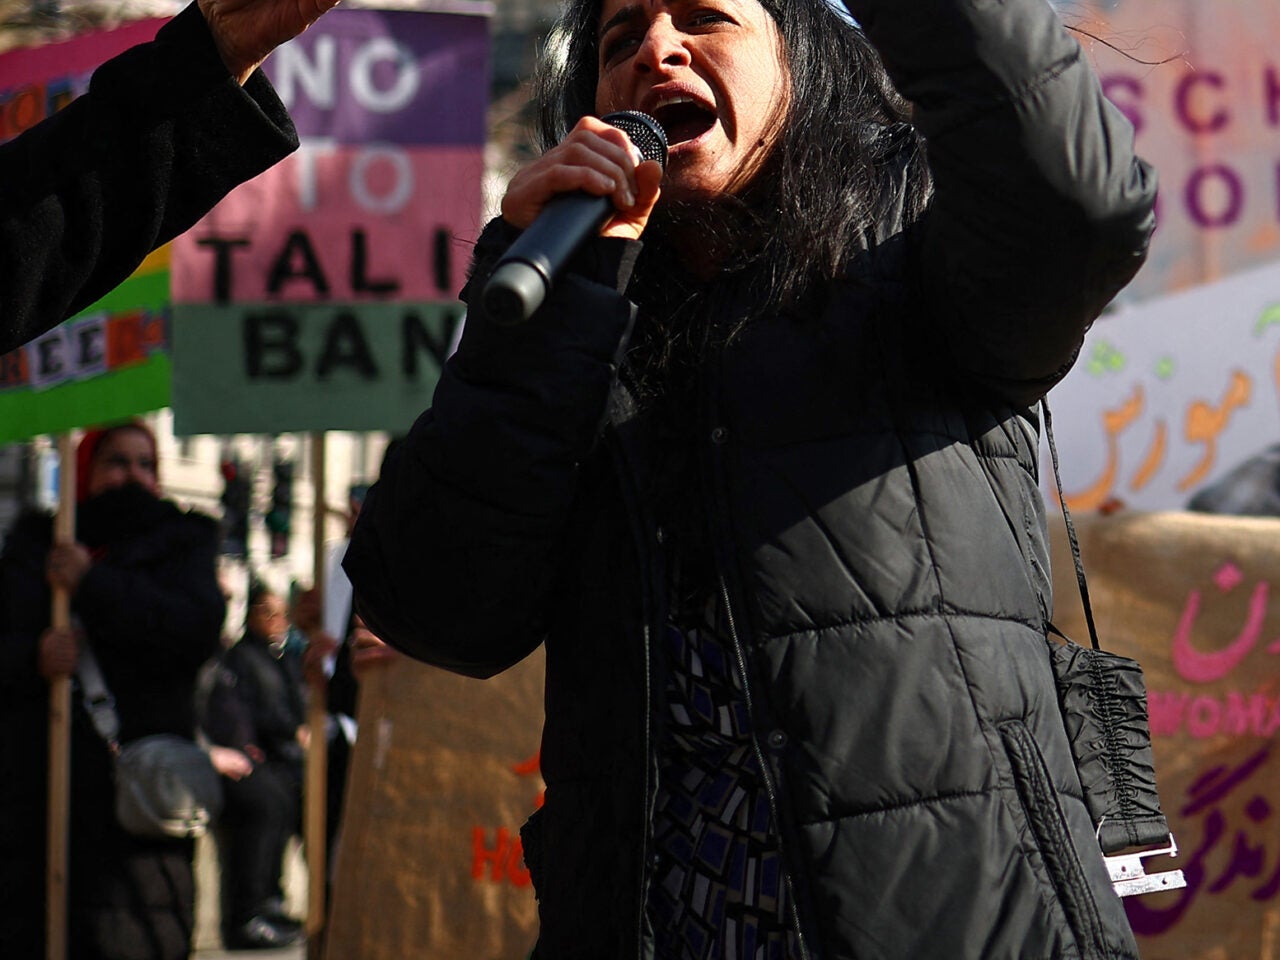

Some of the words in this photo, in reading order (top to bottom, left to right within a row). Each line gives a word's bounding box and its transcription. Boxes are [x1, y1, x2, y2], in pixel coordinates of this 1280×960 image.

[273, 33, 422, 114] NO
[295, 135, 415, 213] TO
[196, 223, 453, 305] TALI
[241, 307, 457, 383] BAN
